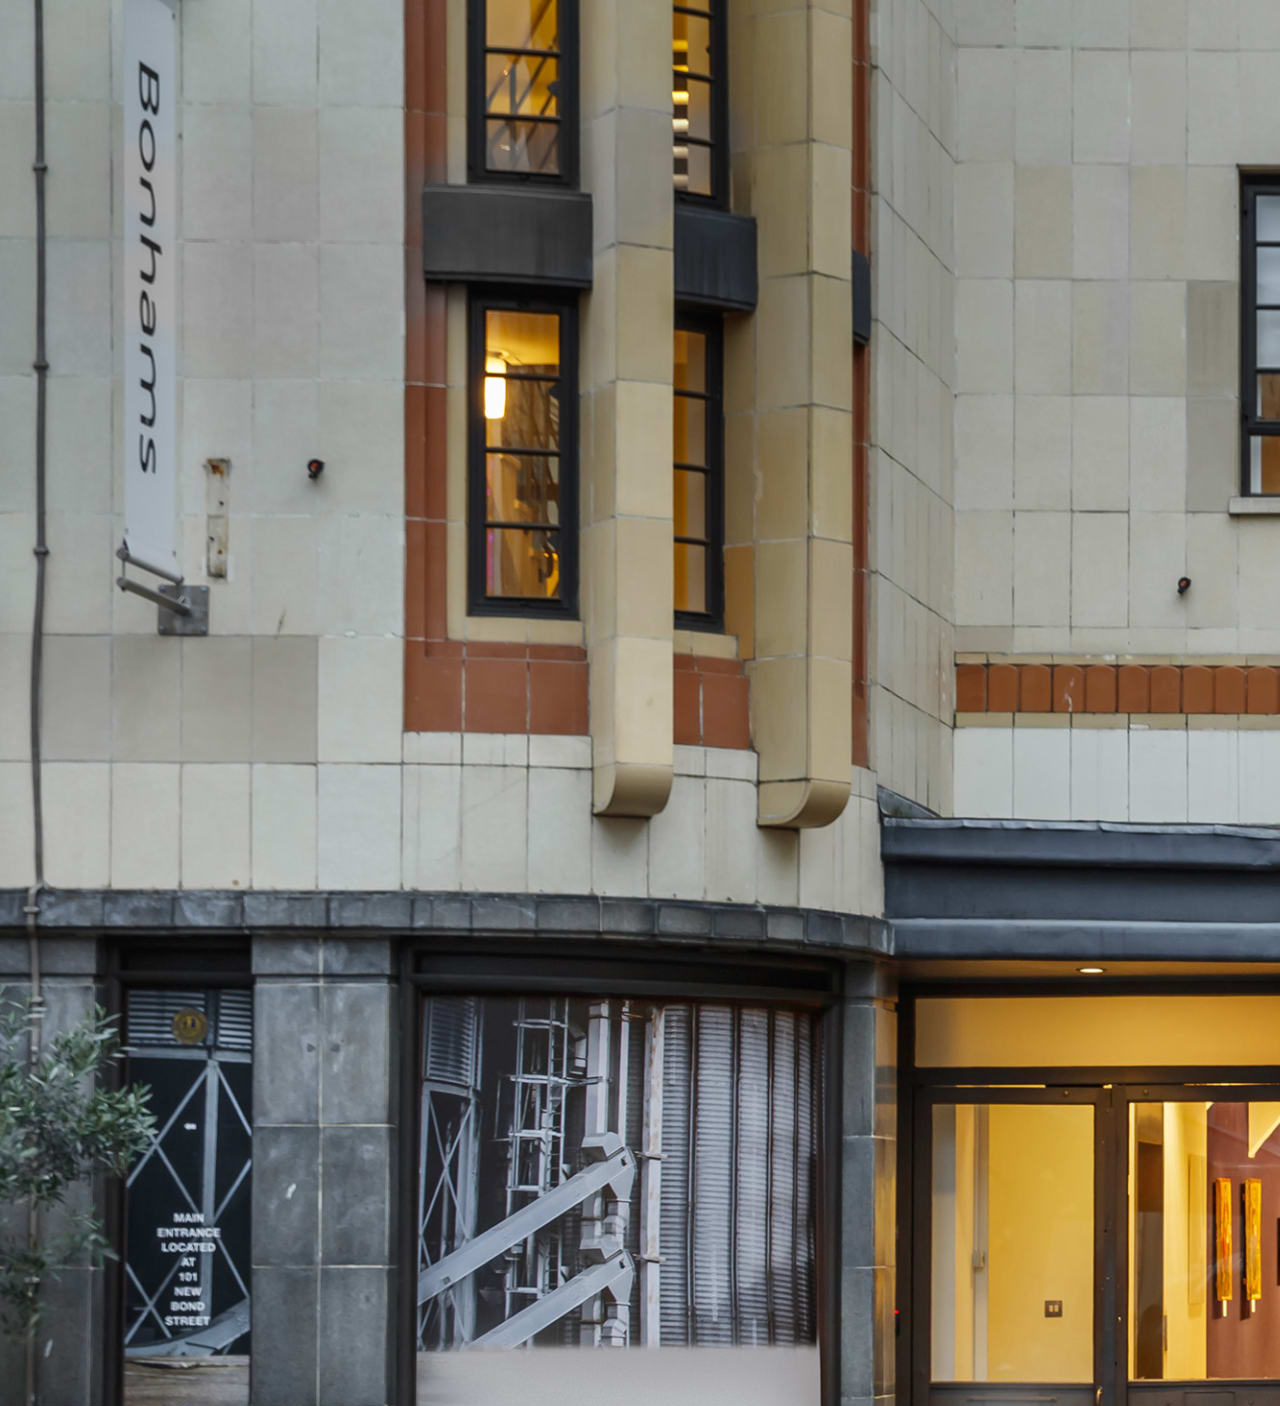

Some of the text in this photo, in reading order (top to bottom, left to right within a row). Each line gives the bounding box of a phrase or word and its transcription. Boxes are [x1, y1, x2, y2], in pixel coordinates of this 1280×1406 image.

[138, 60, 162, 474] Bonhams
[173, 1213, 204, 1223] MAIN
[156, 1228, 221, 1238] ENTRANCE
[161, 1242, 216, 1252] LOCATED
[180, 1257, 196, 1267] AT
[179, 1272, 198, 1282] 101
[174, 1286, 202, 1297] NEW
[170, 1301, 206, 1311] BOND
[165, 1316, 210, 1326] STREET
